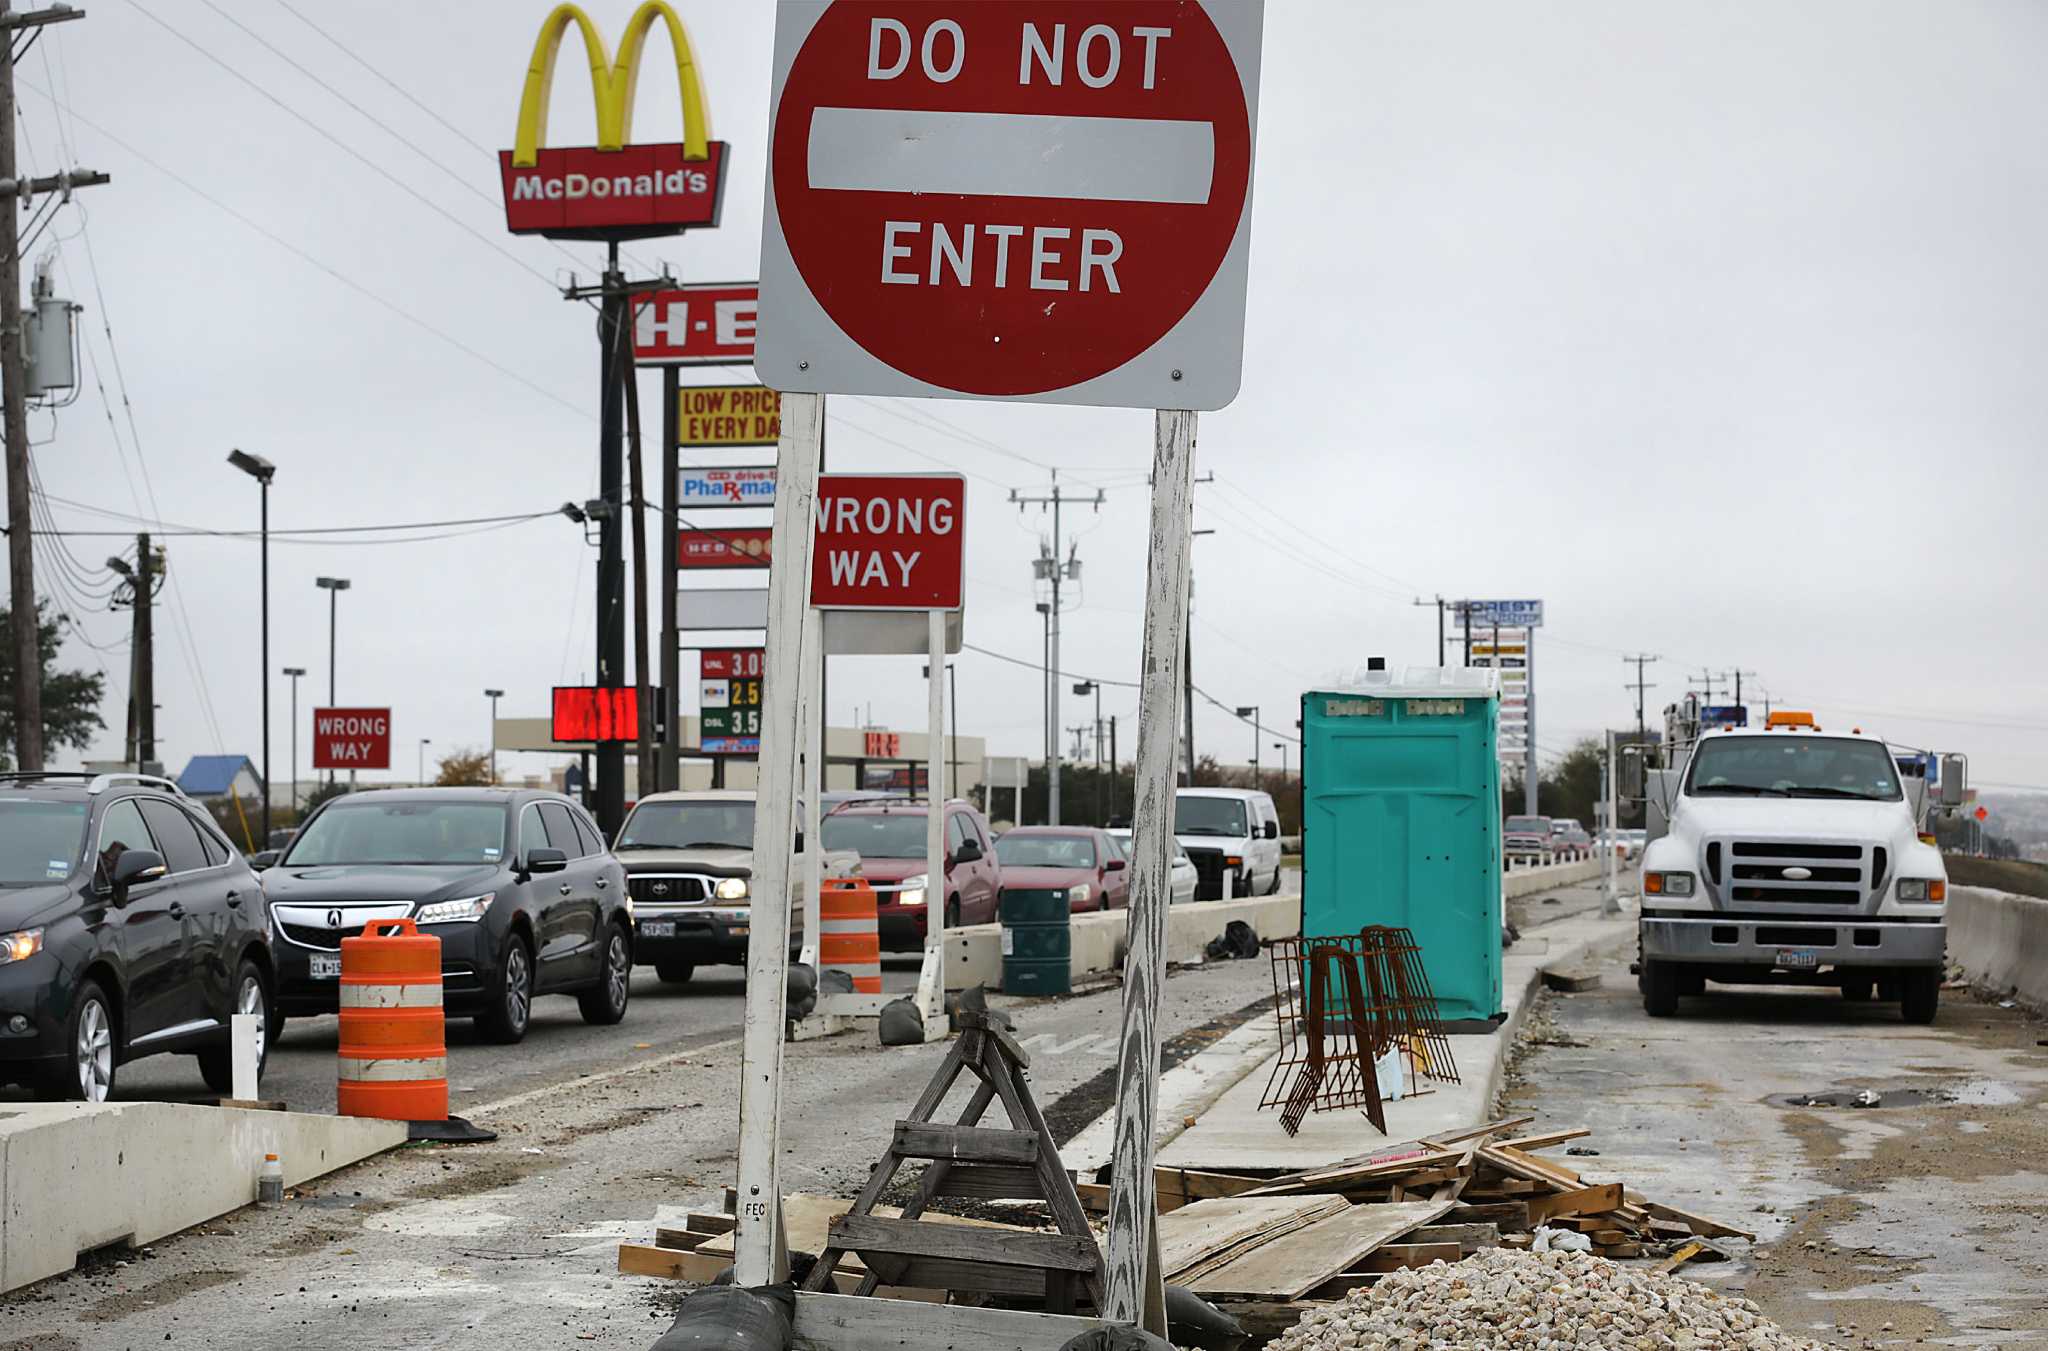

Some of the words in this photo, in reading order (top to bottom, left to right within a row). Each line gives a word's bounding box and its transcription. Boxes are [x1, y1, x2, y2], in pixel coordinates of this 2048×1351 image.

[867, 17, 966, 83] DO
[1019, 22, 1172, 90] NOT
[512, 170, 708, 200] McDonald's
[880, 220, 1124, 293] ENTER
[684, 391, 725, 415] LOW
[689, 417, 749, 440] EVERY
[829, 550, 921, 588] WAY
[318, 717, 387, 736] WRONG
[704, 718, 725, 728] DSL
[330, 742, 373, 761] WAY
[745, 1203, 765, 1216] FEC
